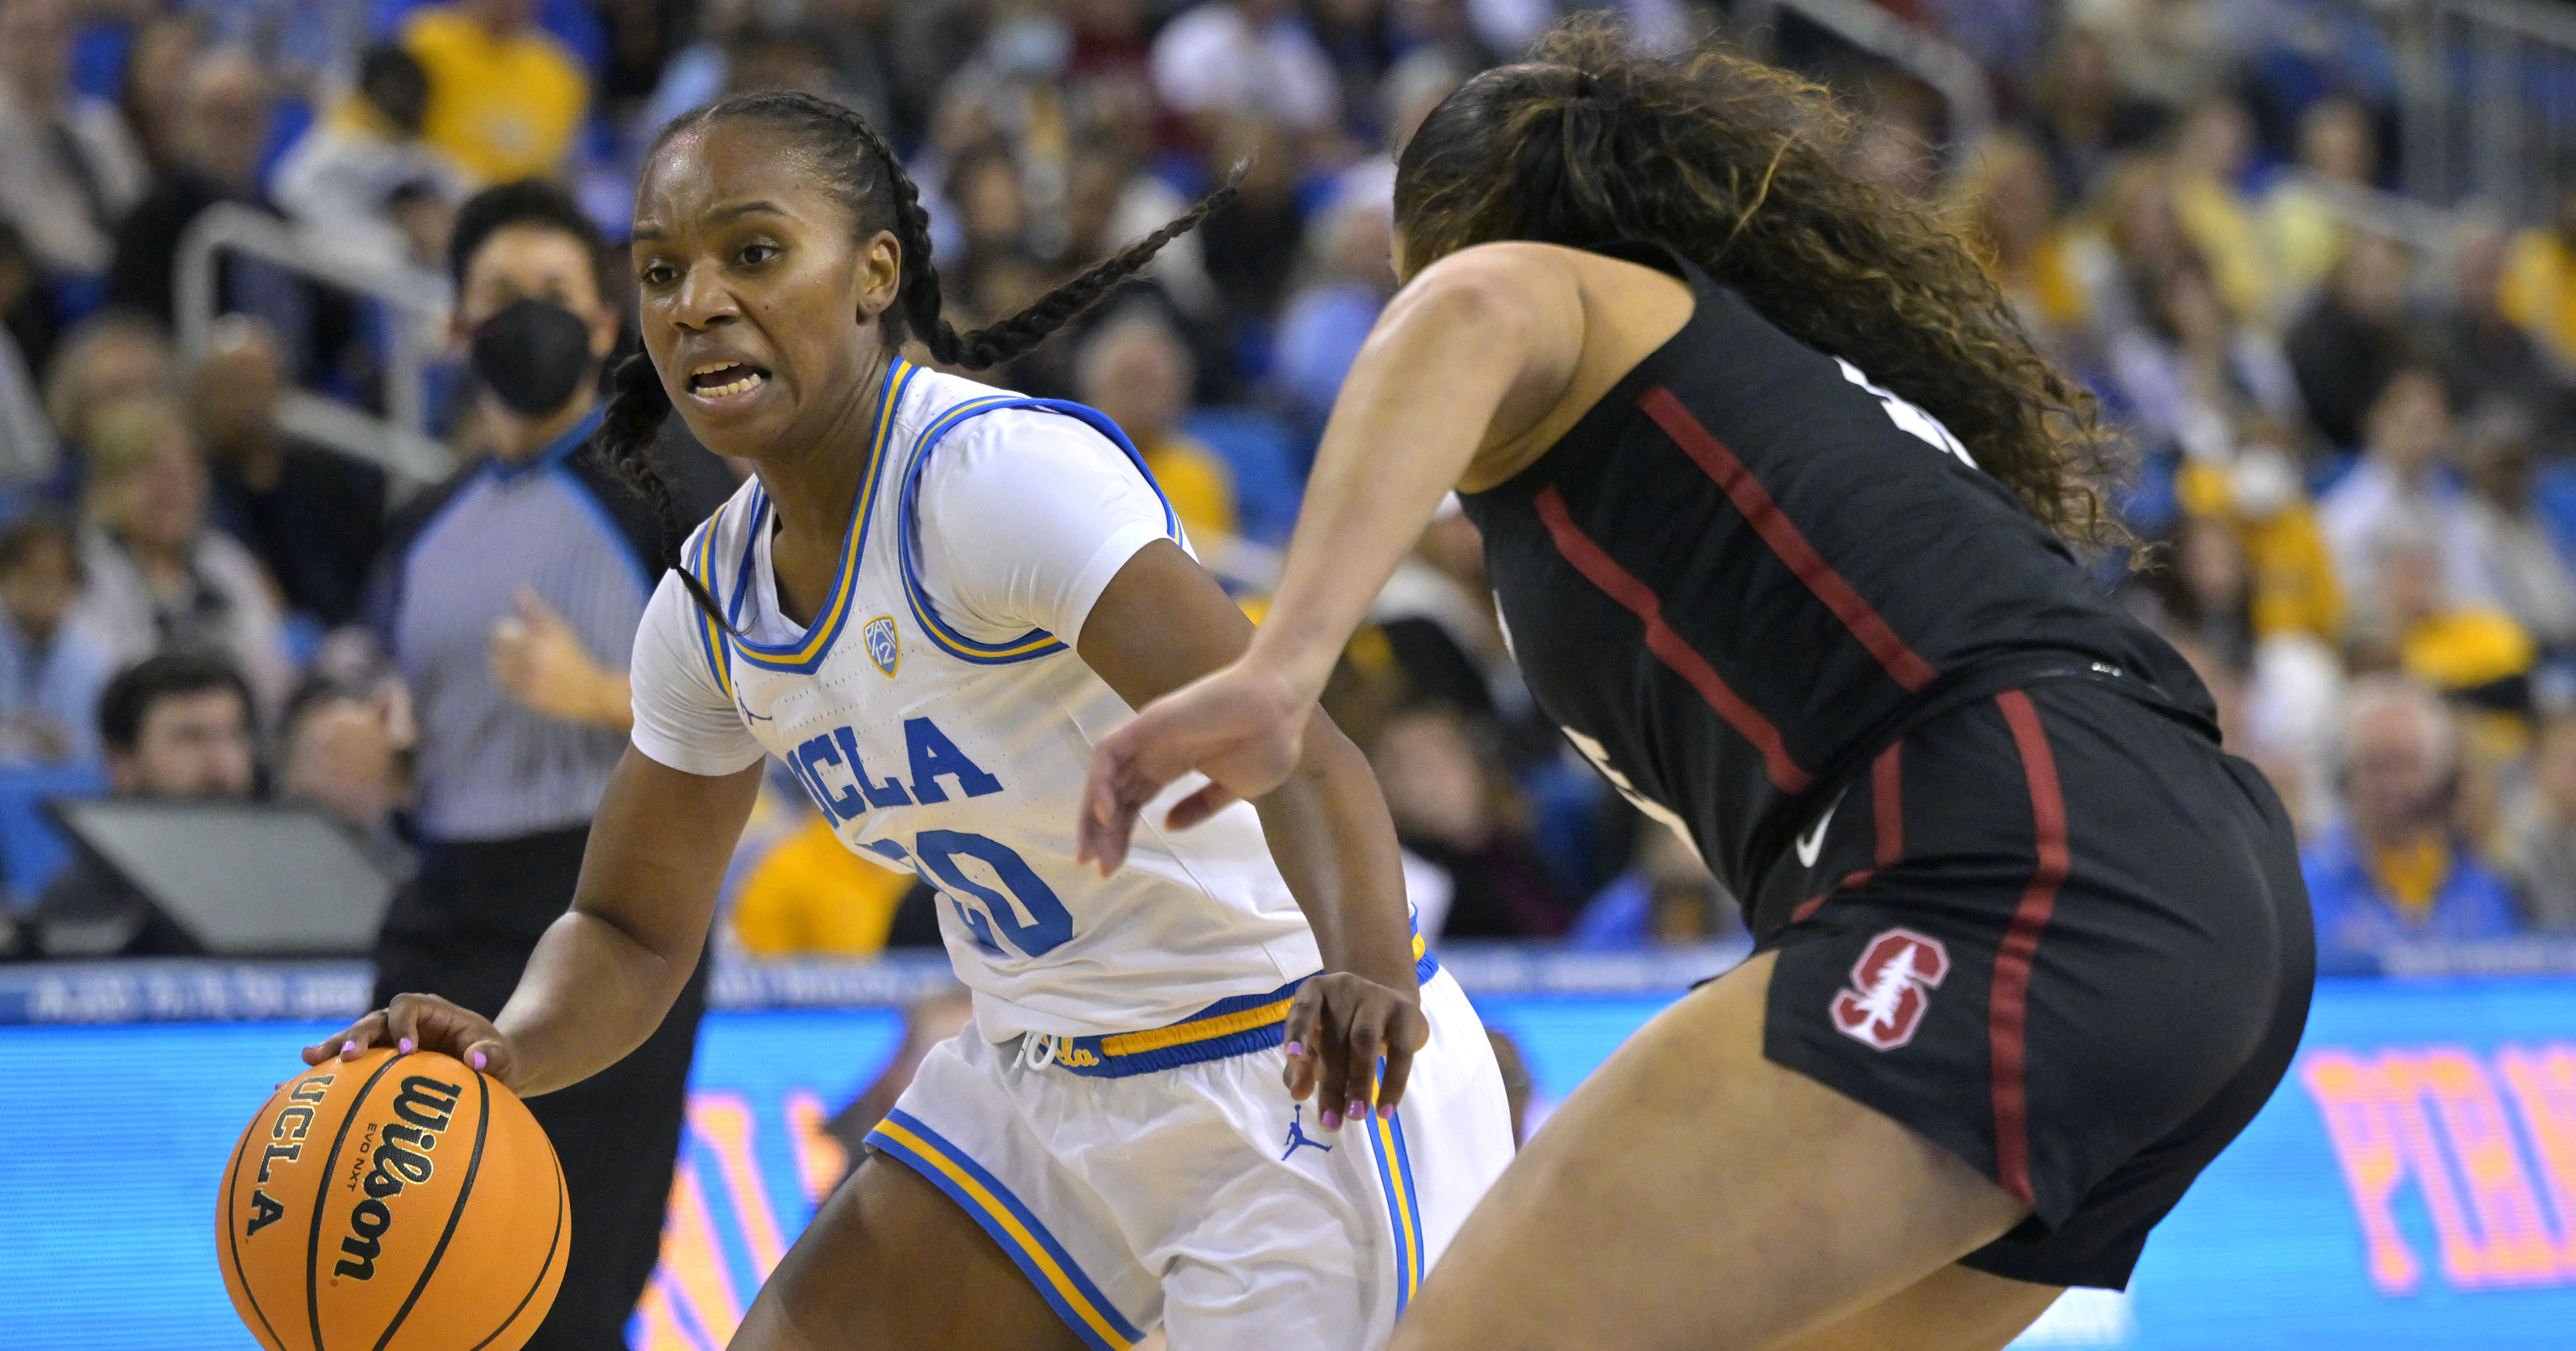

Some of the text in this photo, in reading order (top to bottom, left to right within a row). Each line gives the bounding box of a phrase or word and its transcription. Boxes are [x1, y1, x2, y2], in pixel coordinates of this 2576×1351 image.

[865, 619, 897, 657] PAC
[876, 643, 894, 666] 12
[1041, 1034, 1099, 1067] la
[247, 1074, 335, 1237] UCLA
[334, 1075, 462, 1282] Wilson
[347, 1123, 378, 1192] EVO NXT
